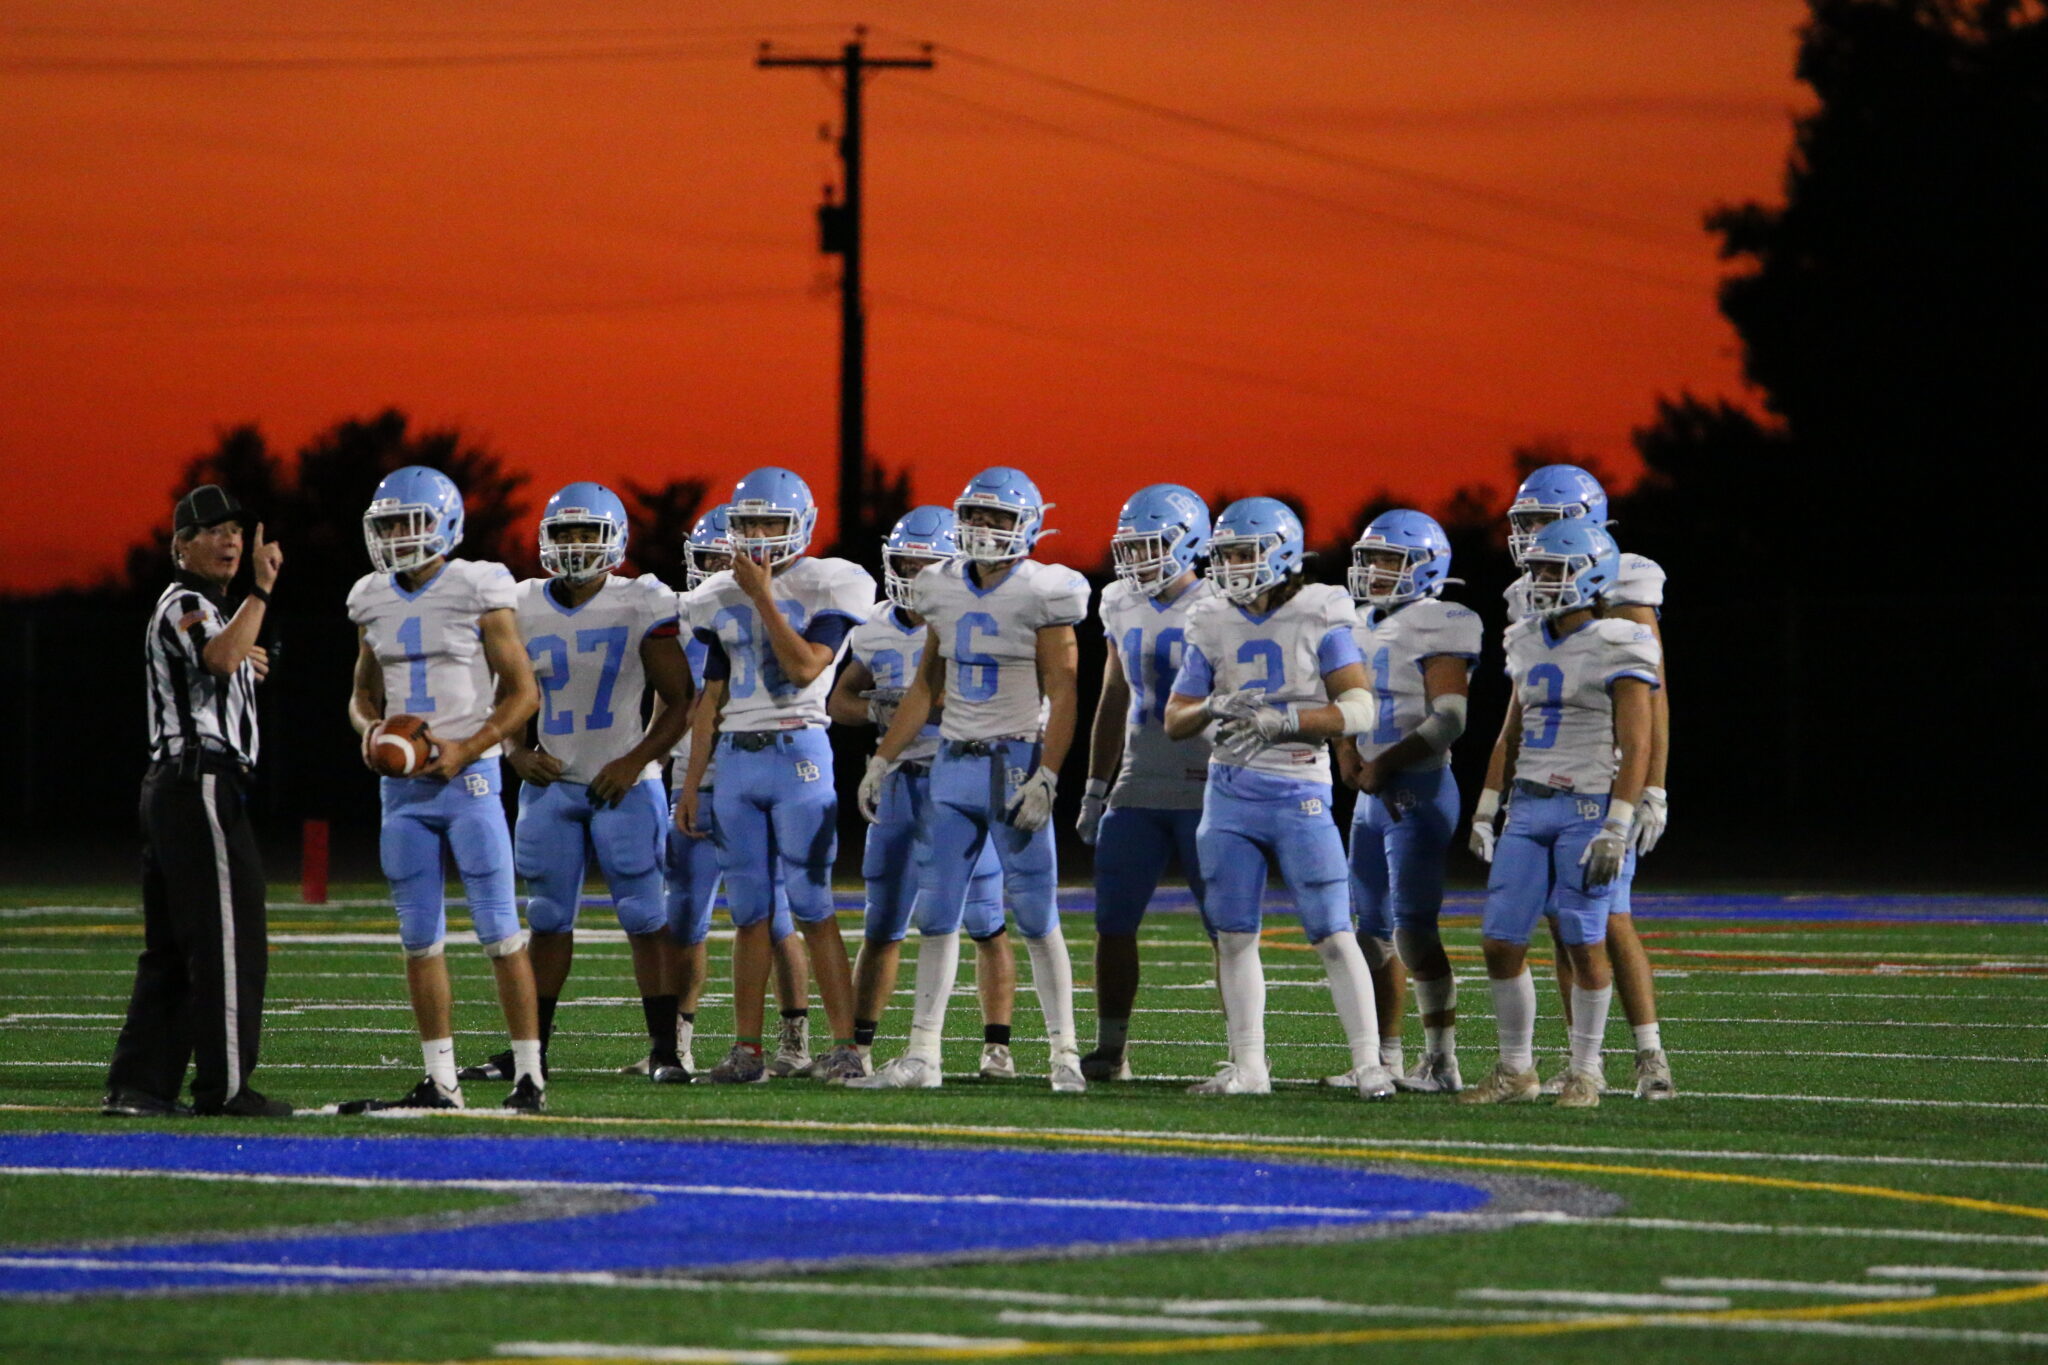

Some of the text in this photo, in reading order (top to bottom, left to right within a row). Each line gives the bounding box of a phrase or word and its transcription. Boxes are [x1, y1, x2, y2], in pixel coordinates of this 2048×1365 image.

[397, 616, 437, 713] 1
[527, 626, 630, 736] 27
[955, 612, 998, 703] 6
[1237, 639, 1286, 714] 2
[1357, 646, 1402, 745] 1
[1524, 663, 1564, 749] 3
[464, 773, 489, 797] DB
[795, 759, 820, 783] DB
